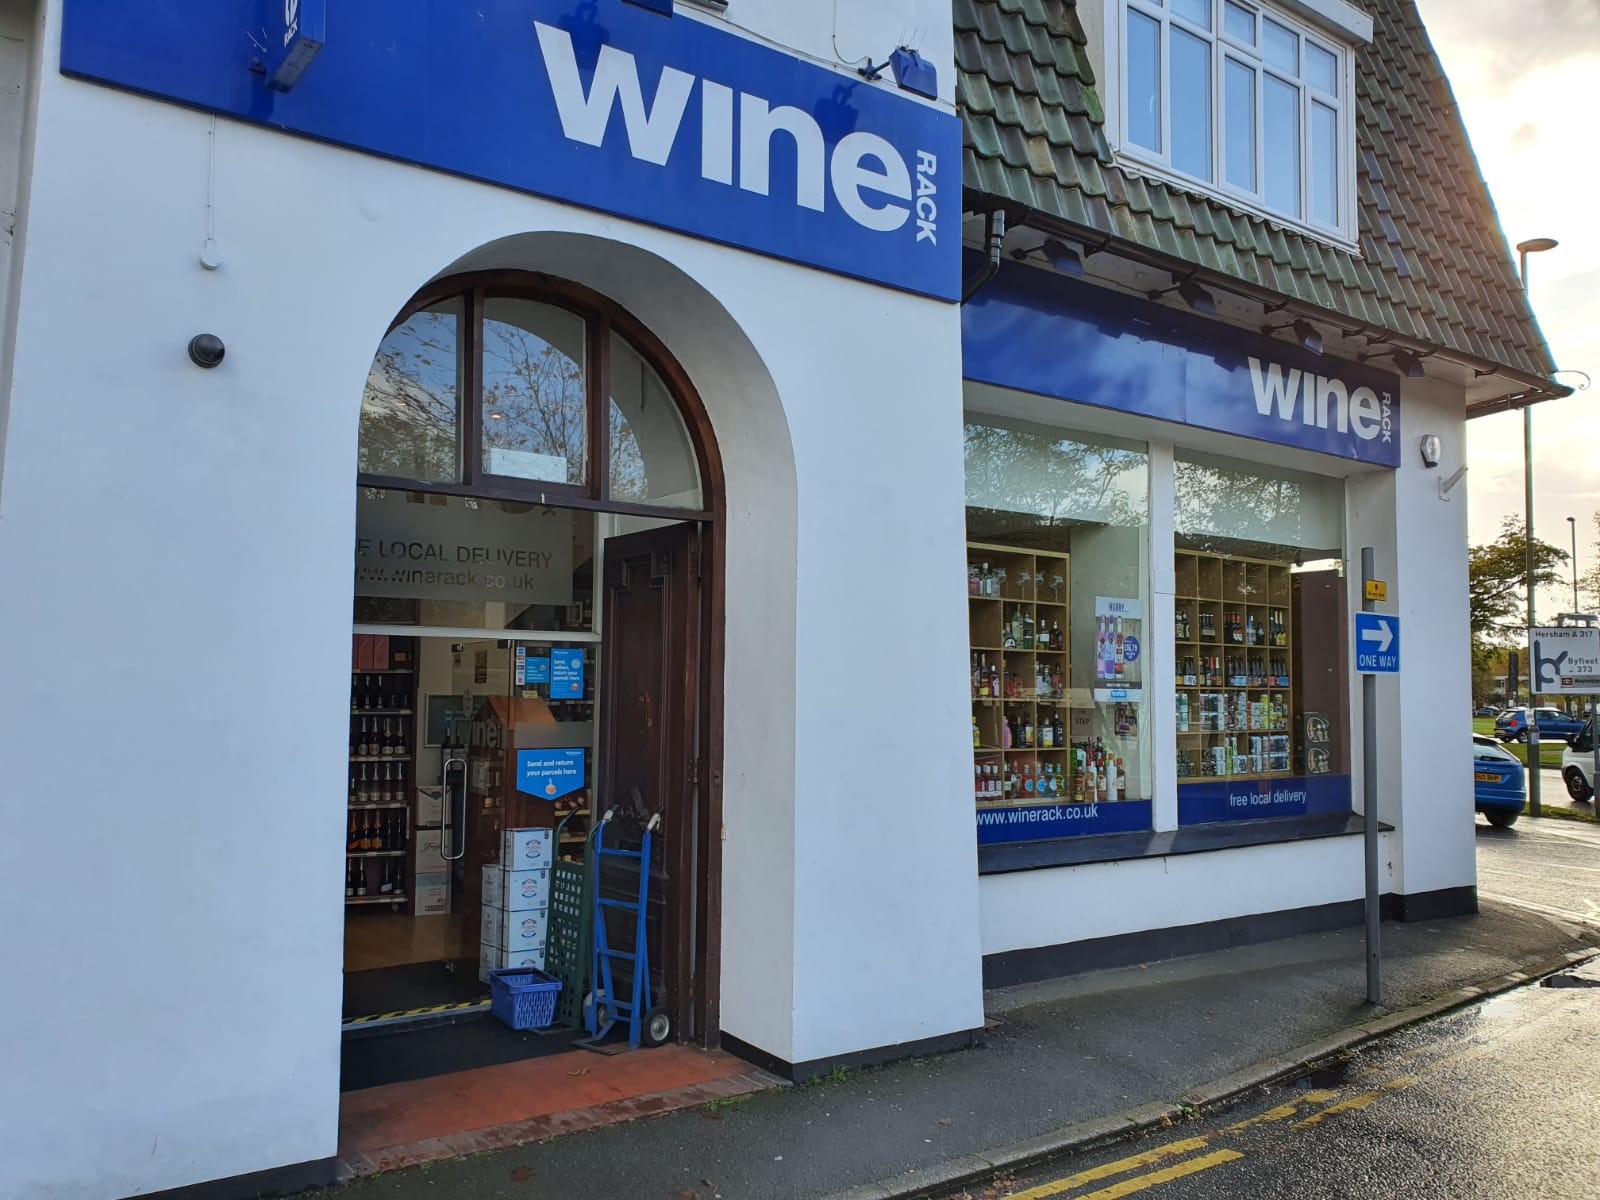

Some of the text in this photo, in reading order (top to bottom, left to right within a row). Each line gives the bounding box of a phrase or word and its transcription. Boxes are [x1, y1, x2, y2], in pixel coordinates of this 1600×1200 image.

[533, 20, 913, 233] wine
[915, 148, 938, 248] RACK
[1247, 356, 1382, 441] wine
[1382, 391, 1392, 444] RACK
[379, 540, 450, 562] LOCAL
[456, 545, 553, 569] DELIVERY
[1535, 630, 1570, 638] Hersham
[1358, 654, 1397, 668] ONE WAY
[526, 770, 540, 778] your
[541, 768, 562, 776] parcels
[1230, 789, 1307, 807] free local delivery
[975, 803, 1098, 826] www.winerack.co.uk
